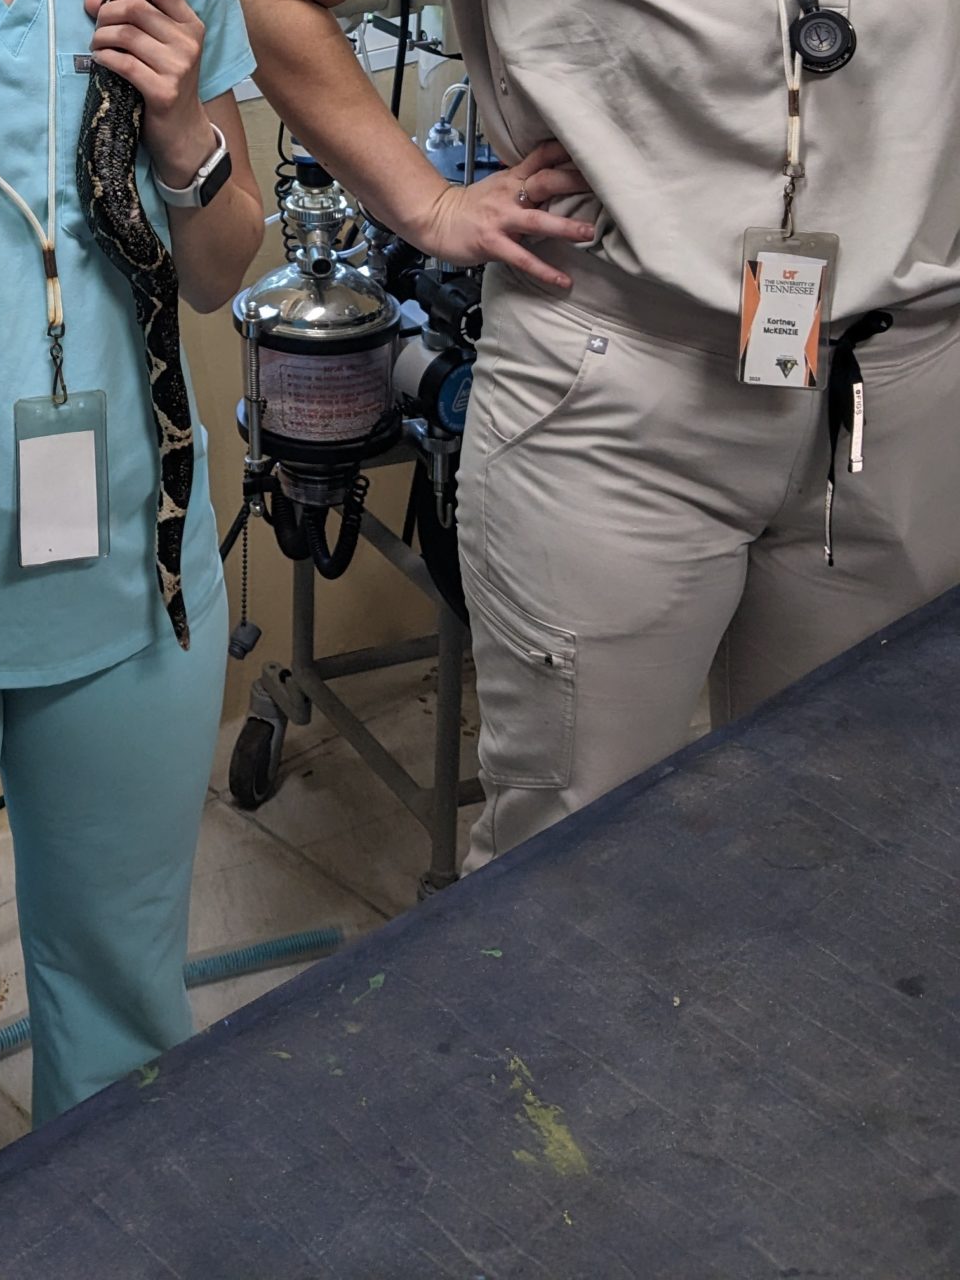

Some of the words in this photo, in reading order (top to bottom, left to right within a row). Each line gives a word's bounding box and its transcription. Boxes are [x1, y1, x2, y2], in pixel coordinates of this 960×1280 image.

[764, 285, 815, 296] TENNESSEE
[767, 318, 796, 327] Kortney
[764, 327, 799, 336] McKENZIE
